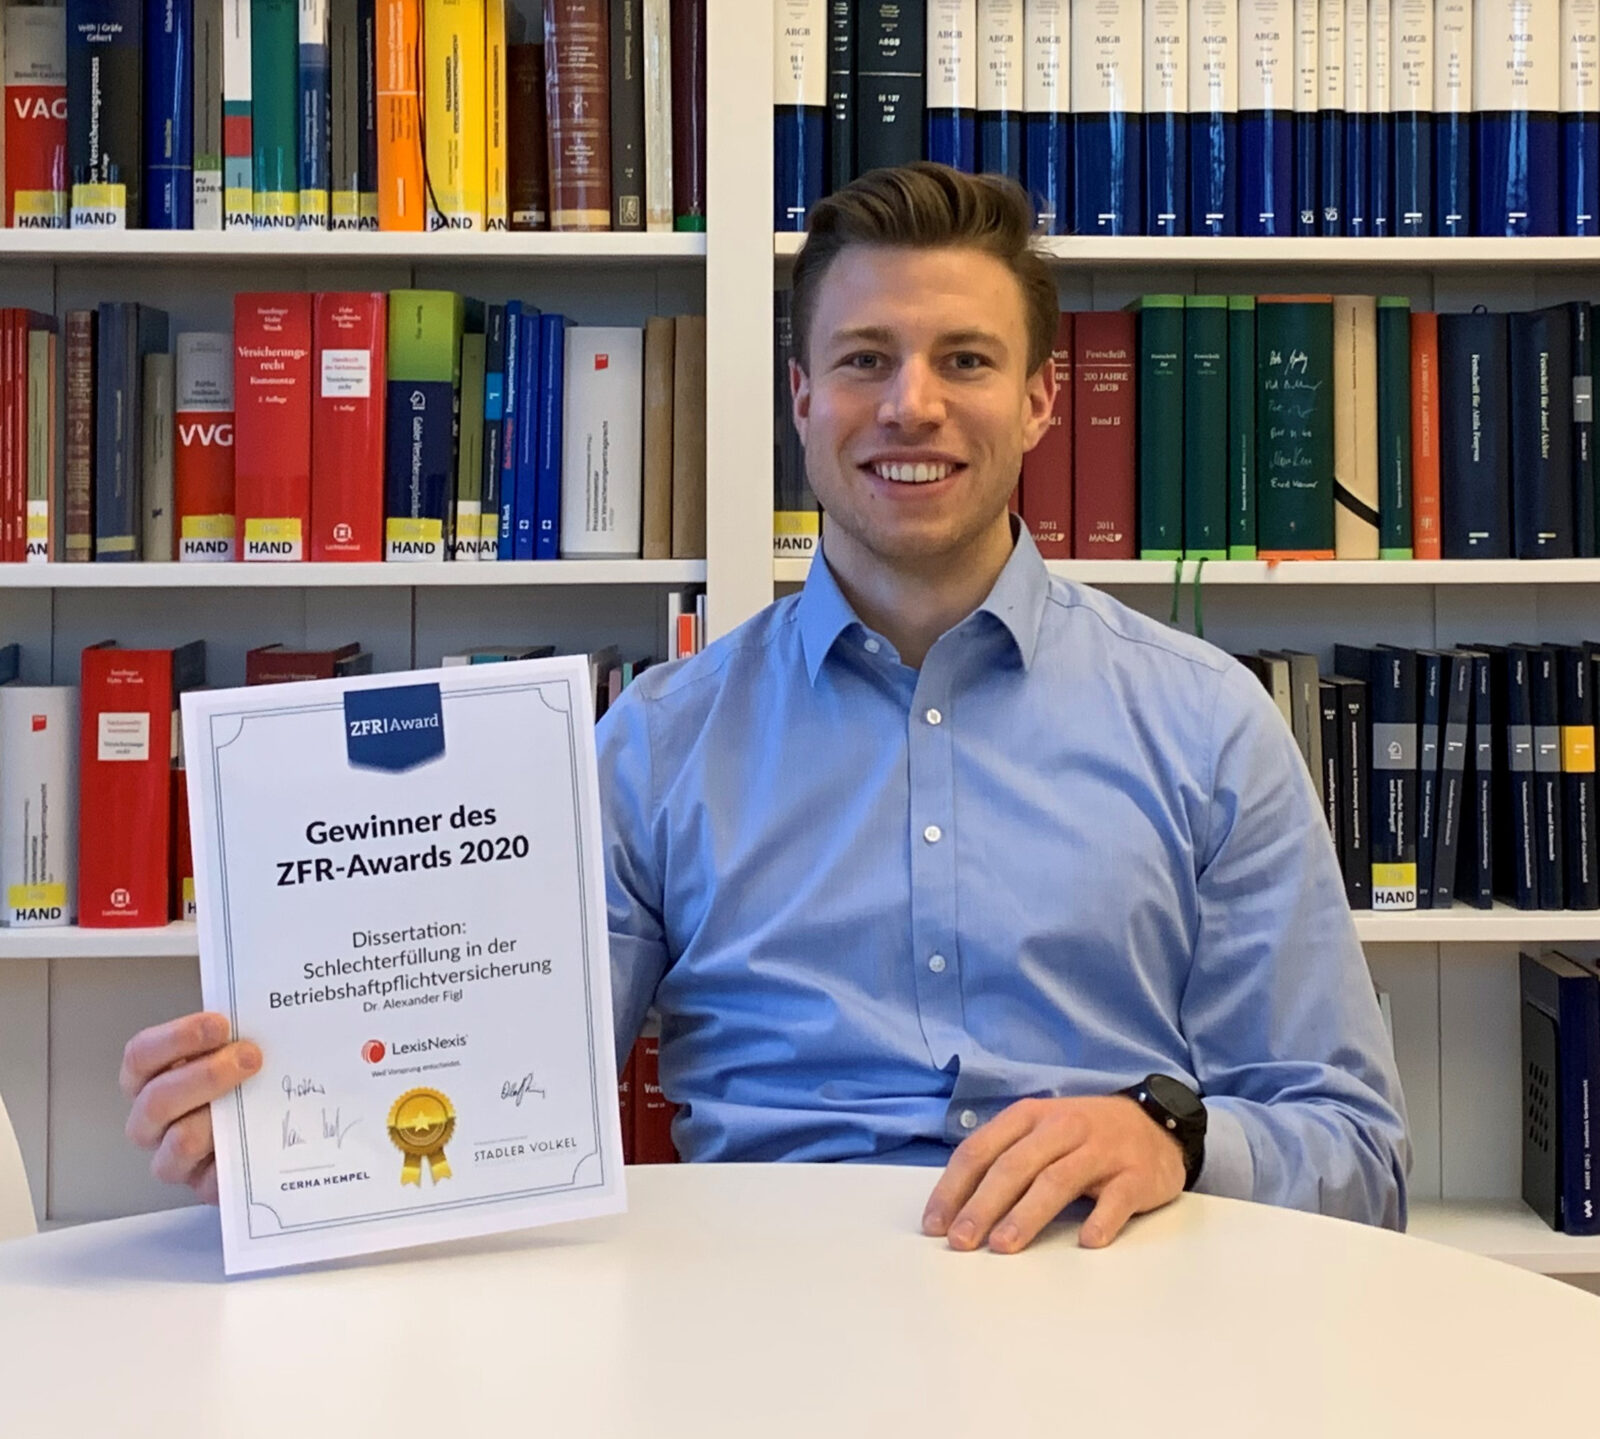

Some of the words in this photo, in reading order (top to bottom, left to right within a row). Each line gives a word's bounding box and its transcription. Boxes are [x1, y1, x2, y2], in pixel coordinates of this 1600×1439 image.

[785, 28, 811, 36] ABGB
[937, 30, 963, 39] ABGB
[1254, 32, 1280, 41] ABGB
[878, 38, 900, 46] ABGB
[988, 34, 1014, 43] ABGB
[1035, 36, 1061, 44] ABGB
[1095, 35, 1121, 44] ABGB
[1155, 36, 1180, 44] ABGB
[1202, 36, 1228, 44] ABGB
[1401, 35, 1427, 43] ABGB
[1507, 34, 1533, 42] ABGB
[1571, 34, 1597, 43] ABGB
[14, 97, 67, 119] VAG
[75, 212, 117, 225] HAND
[254, 215, 296, 227] HAND
[238, 346, 308, 360] Versicherungs-
[1085, 350, 1127, 359] Festschrift
[260, 359, 285, 370] recht
[1099, 372, 1128, 381] JAHRE
[1093, 383, 1119, 392] ABGB
[1091, 417, 1112, 425] Band
[179, 424, 234, 447] VVG
[1039, 521, 1057, 530] 2011
[1096, 521, 1115, 530] 2011
[1089, 533, 1115, 543] MANZ
[185, 541, 228, 553] HAND
[249, 541, 292, 554] HAND
[392, 541, 435, 554] HAND
[306, 813, 442, 845] Gewinner
[449, 804, 497, 830] des
[276, 845, 452, 887] ZFR-Awards
[459, 835, 530, 865] 2020
[1374, 890, 1415, 905] HAND
[16, 907, 62, 920] HAND
[352, 921, 467, 949] Dissertation:
[303, 945, 461, 980] Schlechterfüllung
[466, 941, 482, 958] in
[487, 936, 517, 955] der
[269, 958, 552, 1009] Betriebshaftpflichtversicherung
[382, 994, 440, 1010] Alexander
[442, 989, 463, 1004] Figl
[474, 1145, 525, 1162] STADLER
[280, 1178, 320, 1191] CERHA
[324, 1171, 371, 1185] HEMPEL
